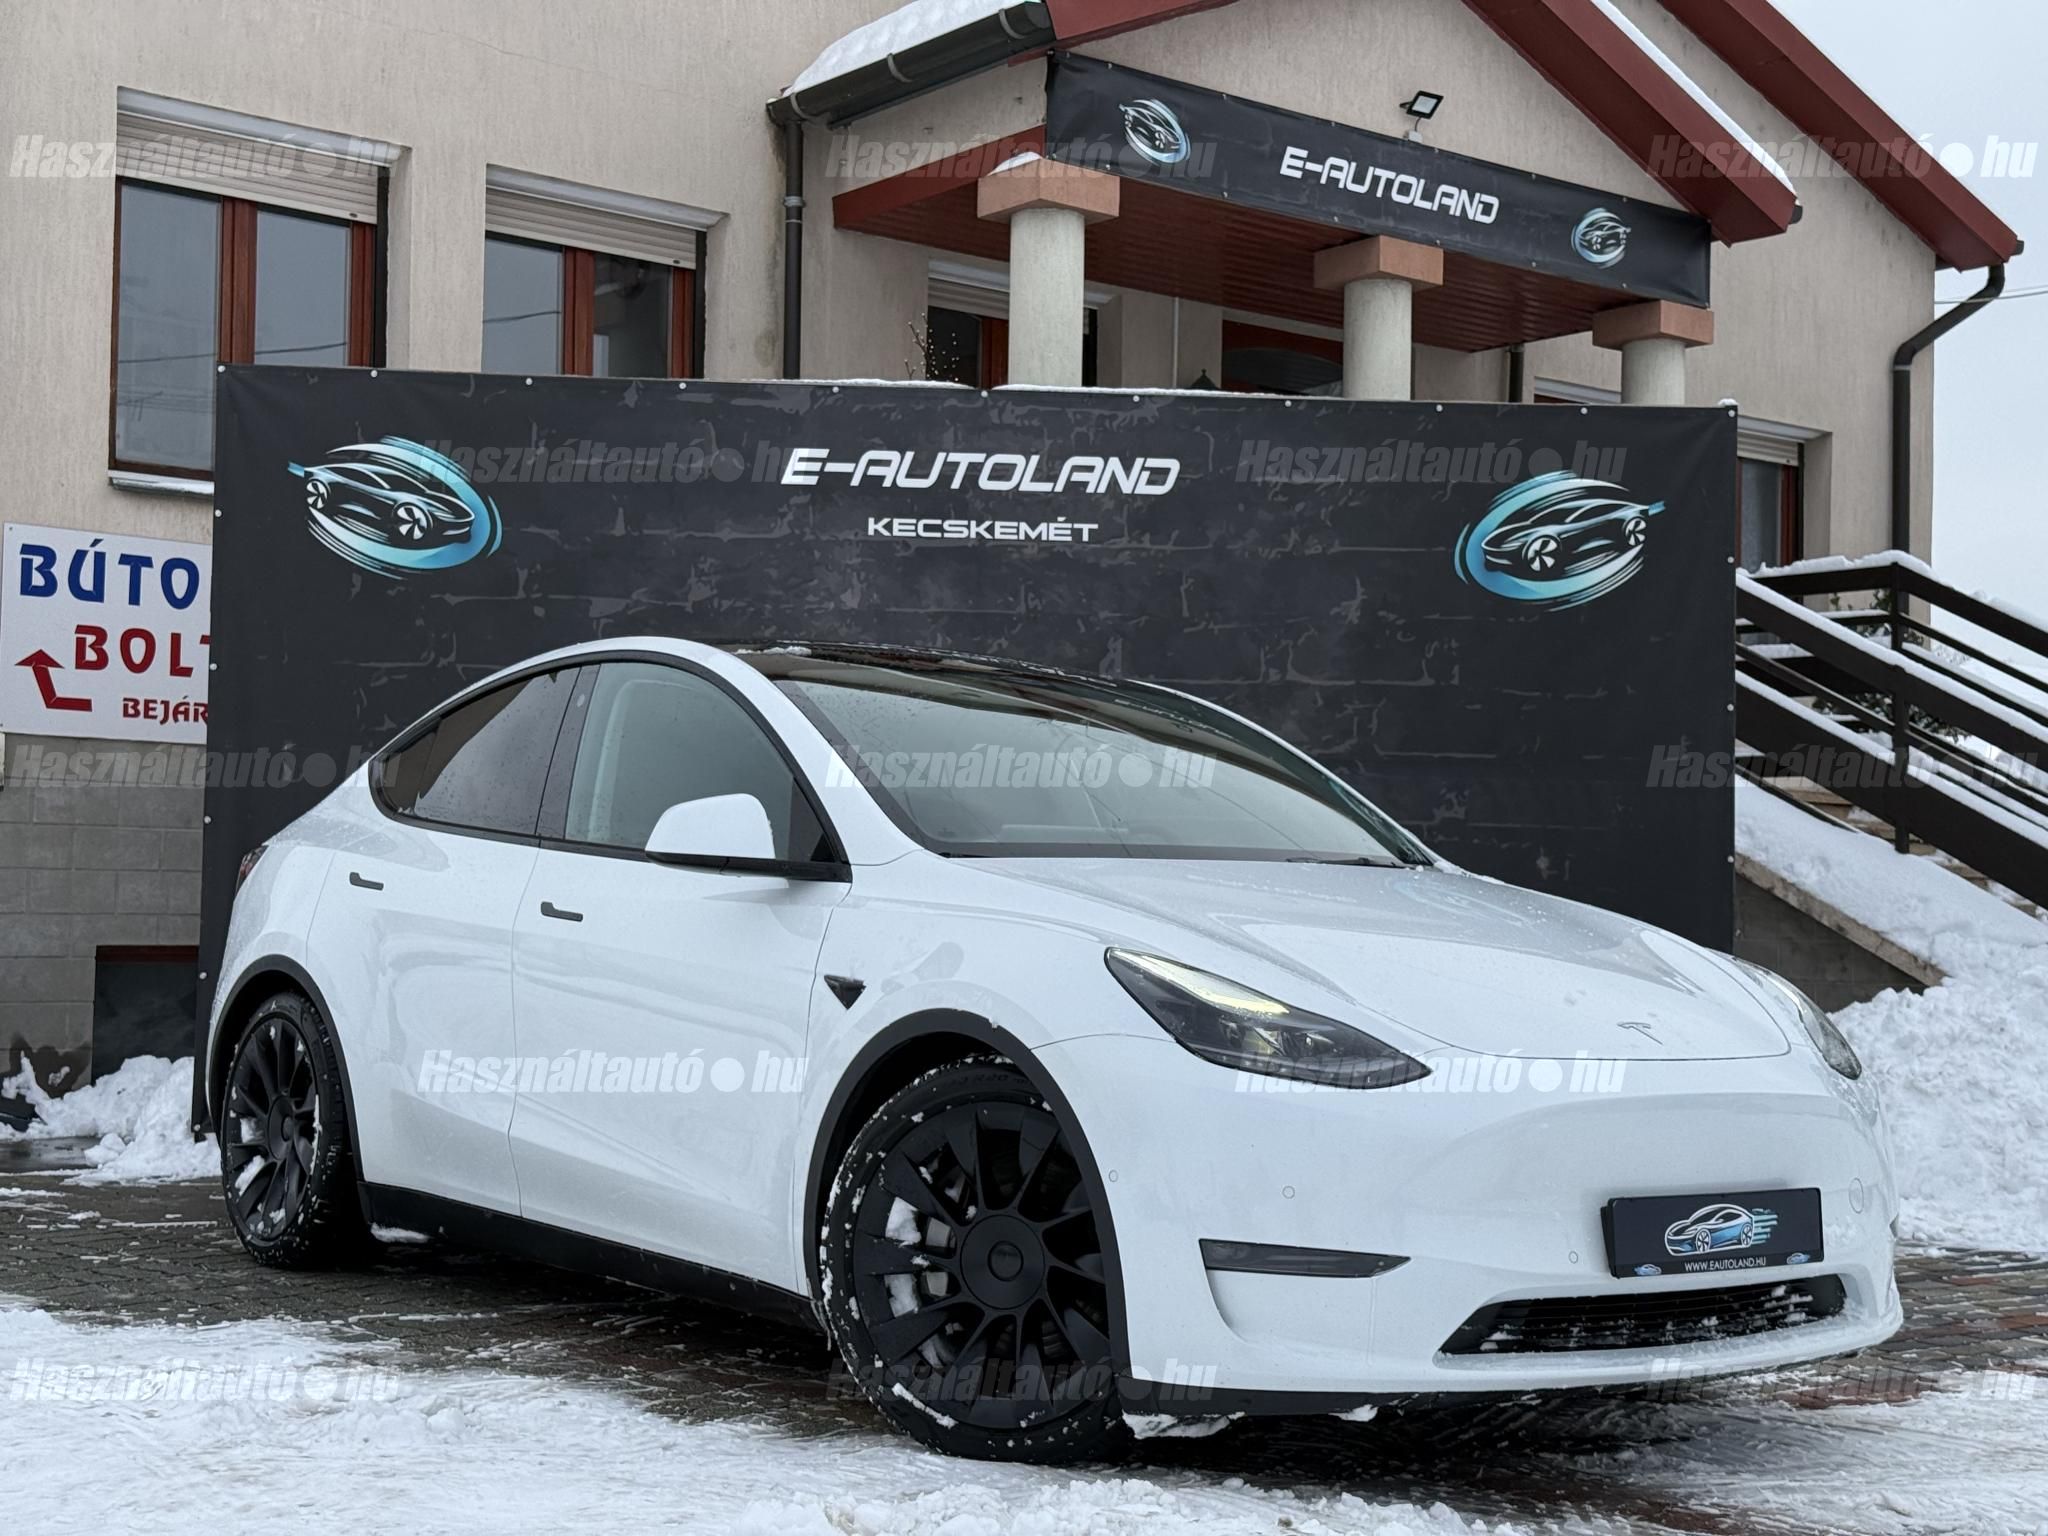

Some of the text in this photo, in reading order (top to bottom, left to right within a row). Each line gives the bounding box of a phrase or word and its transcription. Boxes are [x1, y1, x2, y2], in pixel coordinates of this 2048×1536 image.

[1279, 145, 1499, 224] E-AUTOLAND
[780, 447, 1181, 496] E-AUTOLAND
[867, 516, 1099, 542] KECSKEMÉT
[19, 538, 200, 610] BÚTO
[1684, 1256, 1767, 1272] WWW.EAUTOLAND.HU
